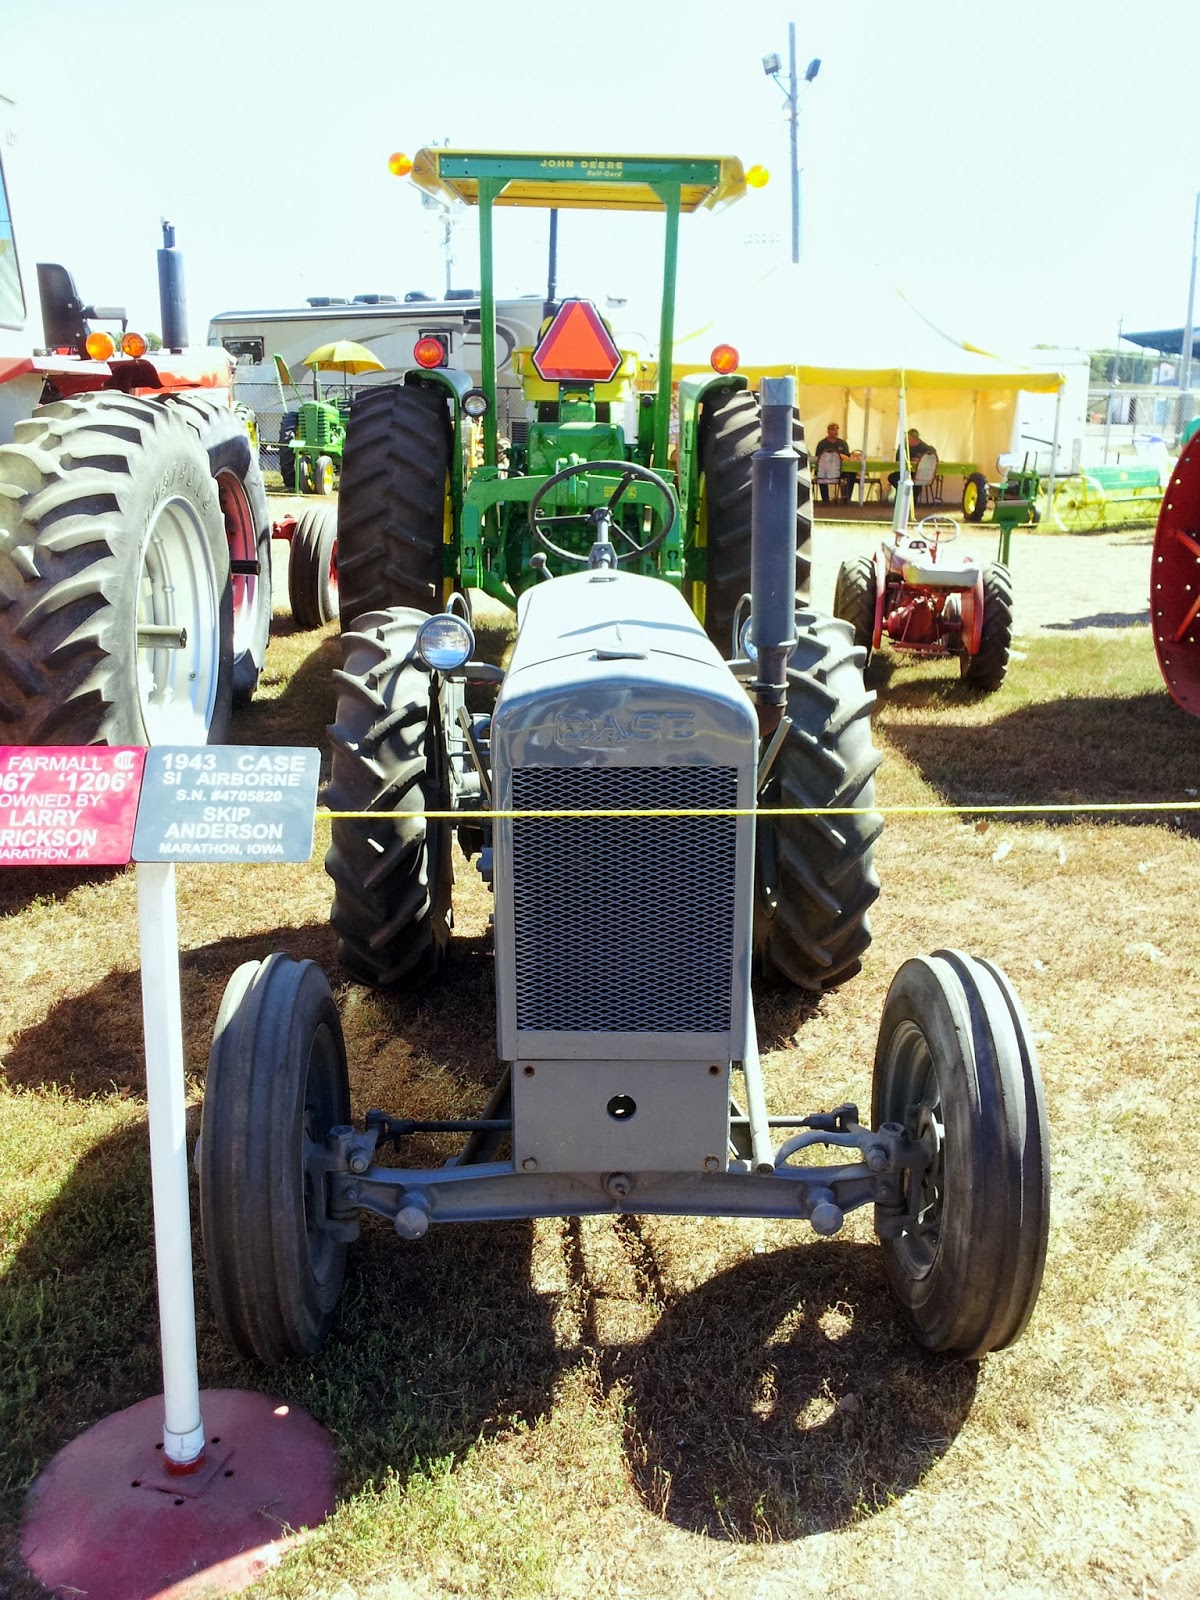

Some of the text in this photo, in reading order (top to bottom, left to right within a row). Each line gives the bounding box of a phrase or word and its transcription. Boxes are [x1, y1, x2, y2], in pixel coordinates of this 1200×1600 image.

[540, 160, 623, 169] JOHN DEERE
[554, 711, 695, 747] CASE
[8, 756, 103, 771] FARMALL
[162, 753, 306, 772] 1943 CASE
[0, 772, 35, 792] 67
[162, 771, 300, 787] SI AIRBORNE
[0, 793, 103, 807] OWNED BY
[175, 789, 283, 802] S.N. #4705820
[9, 809, 82, 827] LARRY
[202, 806, 251, 822] SKIP
[0, 828, 97, 847] RICKSON
[164, 823, 283, 840] ANDERSON
[0, 848, 90, 860] ARATHON, IA
[159, 843, 285, 856] MARATHON, IOWA
